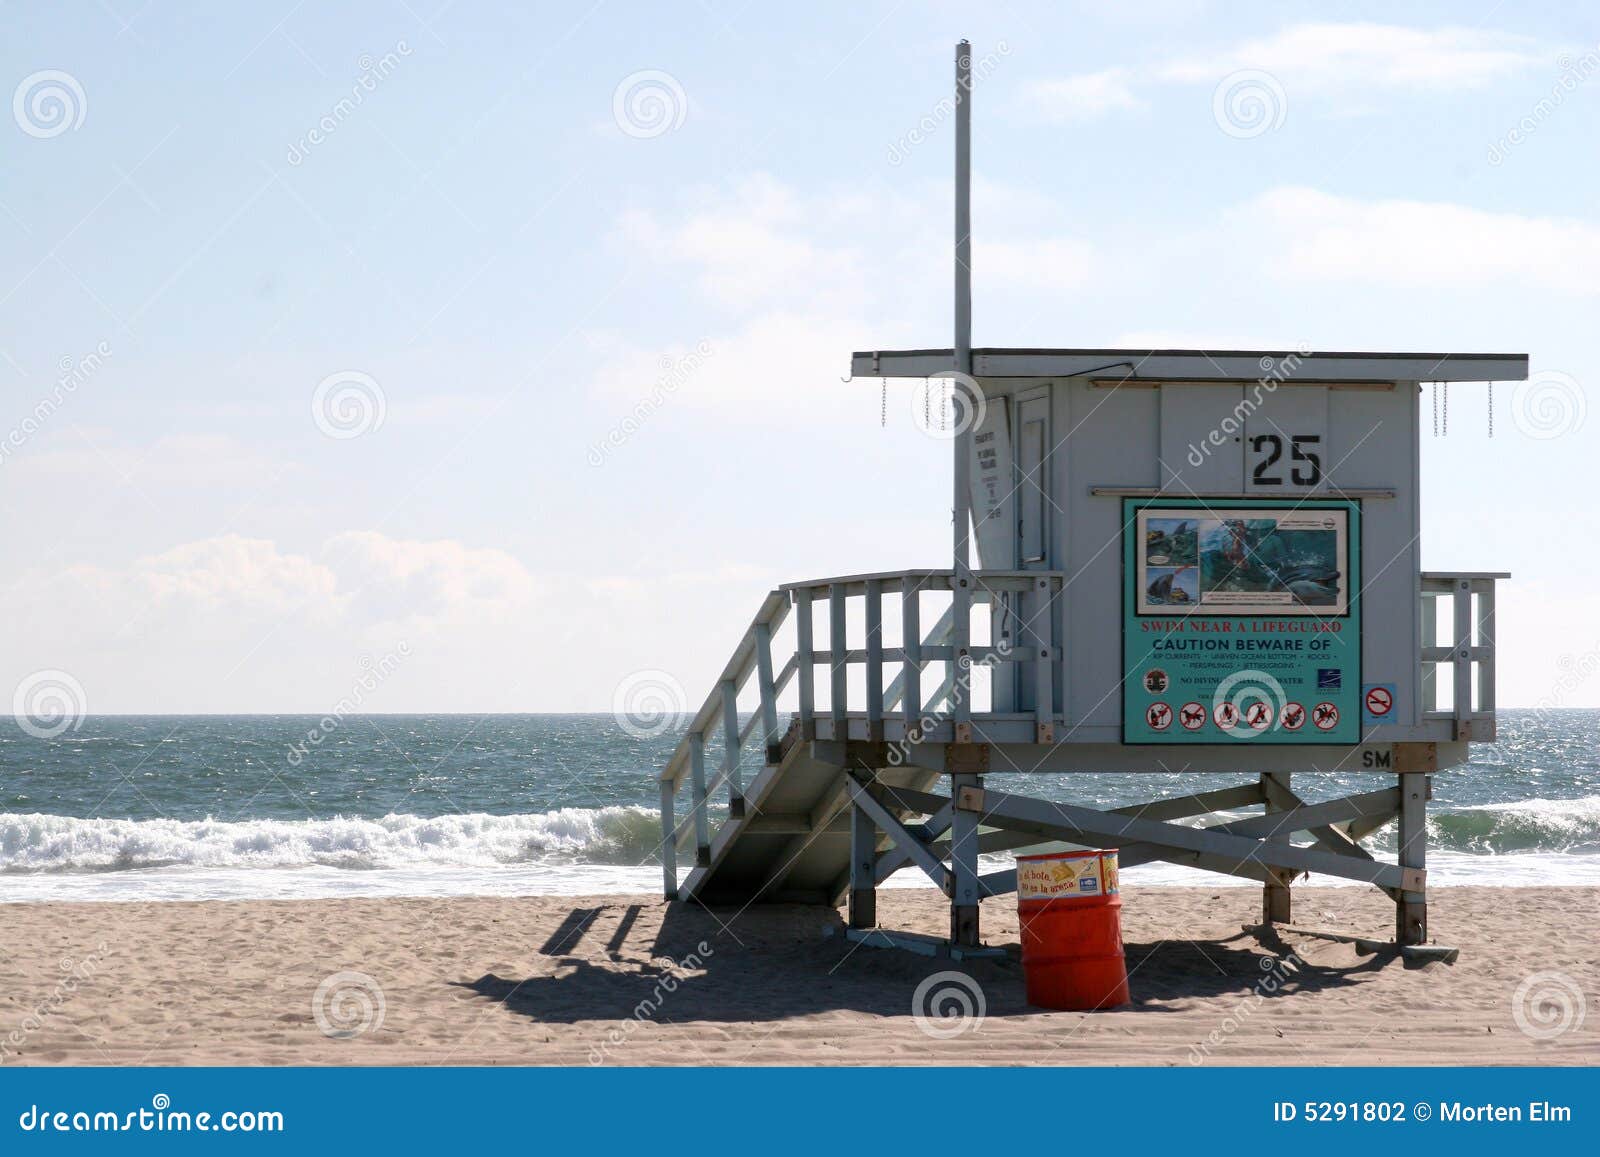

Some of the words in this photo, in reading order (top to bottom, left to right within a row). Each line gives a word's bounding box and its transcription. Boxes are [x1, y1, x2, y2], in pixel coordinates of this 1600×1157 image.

[1253, 435, 1321, 485] 25
[1141, 621, 1185, 633] SWIM
[1190, 621, 1233, 633] NEAR
[1237, 621, 1247, 633] A
[1252, 621, 1342, 633] LIFEGUARD
[1152, 639, 1230, 651] CAUTION
[1236, 639, 1303, 651] BEWARE
[1309, 639, 1331, 651] OF
[1362, 751, 1391, 769] SM
